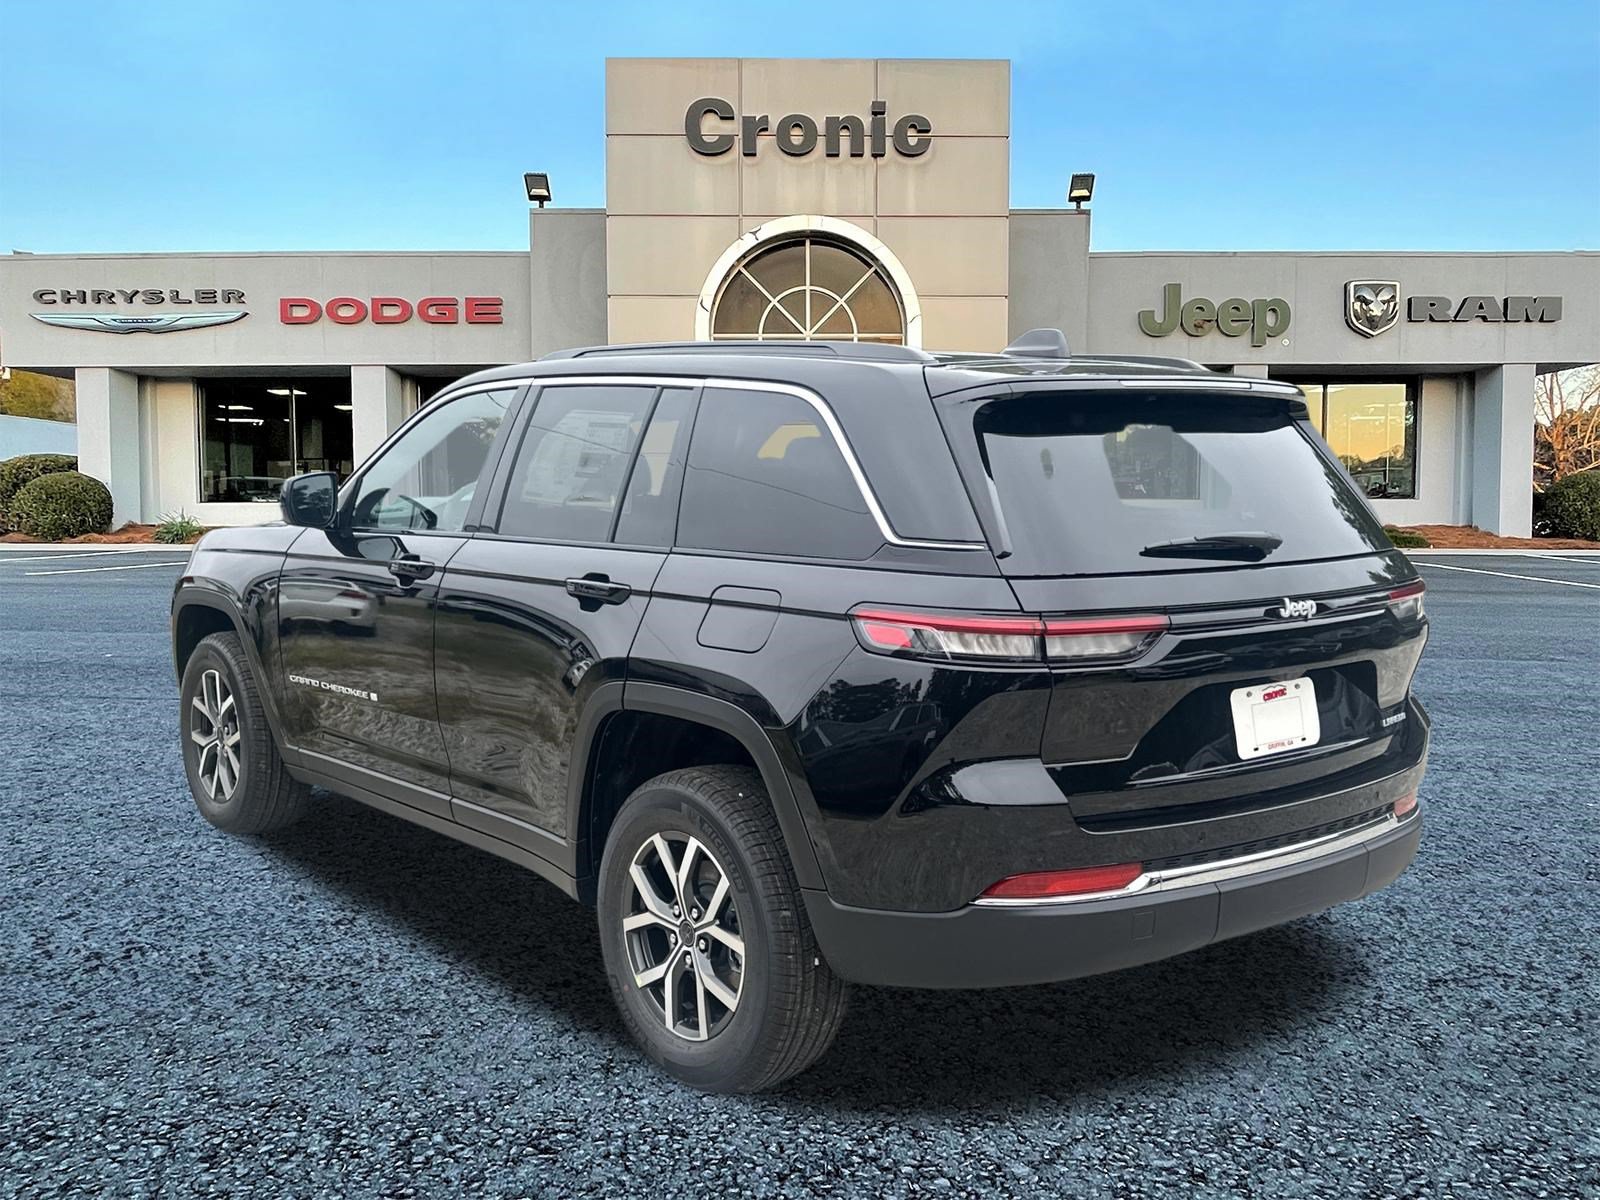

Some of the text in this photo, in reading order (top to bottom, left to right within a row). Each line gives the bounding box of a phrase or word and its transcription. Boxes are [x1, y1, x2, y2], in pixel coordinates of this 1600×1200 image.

[684, 97, 932, 158] Cronic
[32, 288, 248, 305] CHRYSLER
[1407, 296, 1563, 323] RAM
[279, 297, 504, 324] DODGE
[1138, 283, 1291, 347] Jeep
[1279, 597, 1317, 619] Jeep
[289, 675, 368, 699] GRAND CHEROKEE
